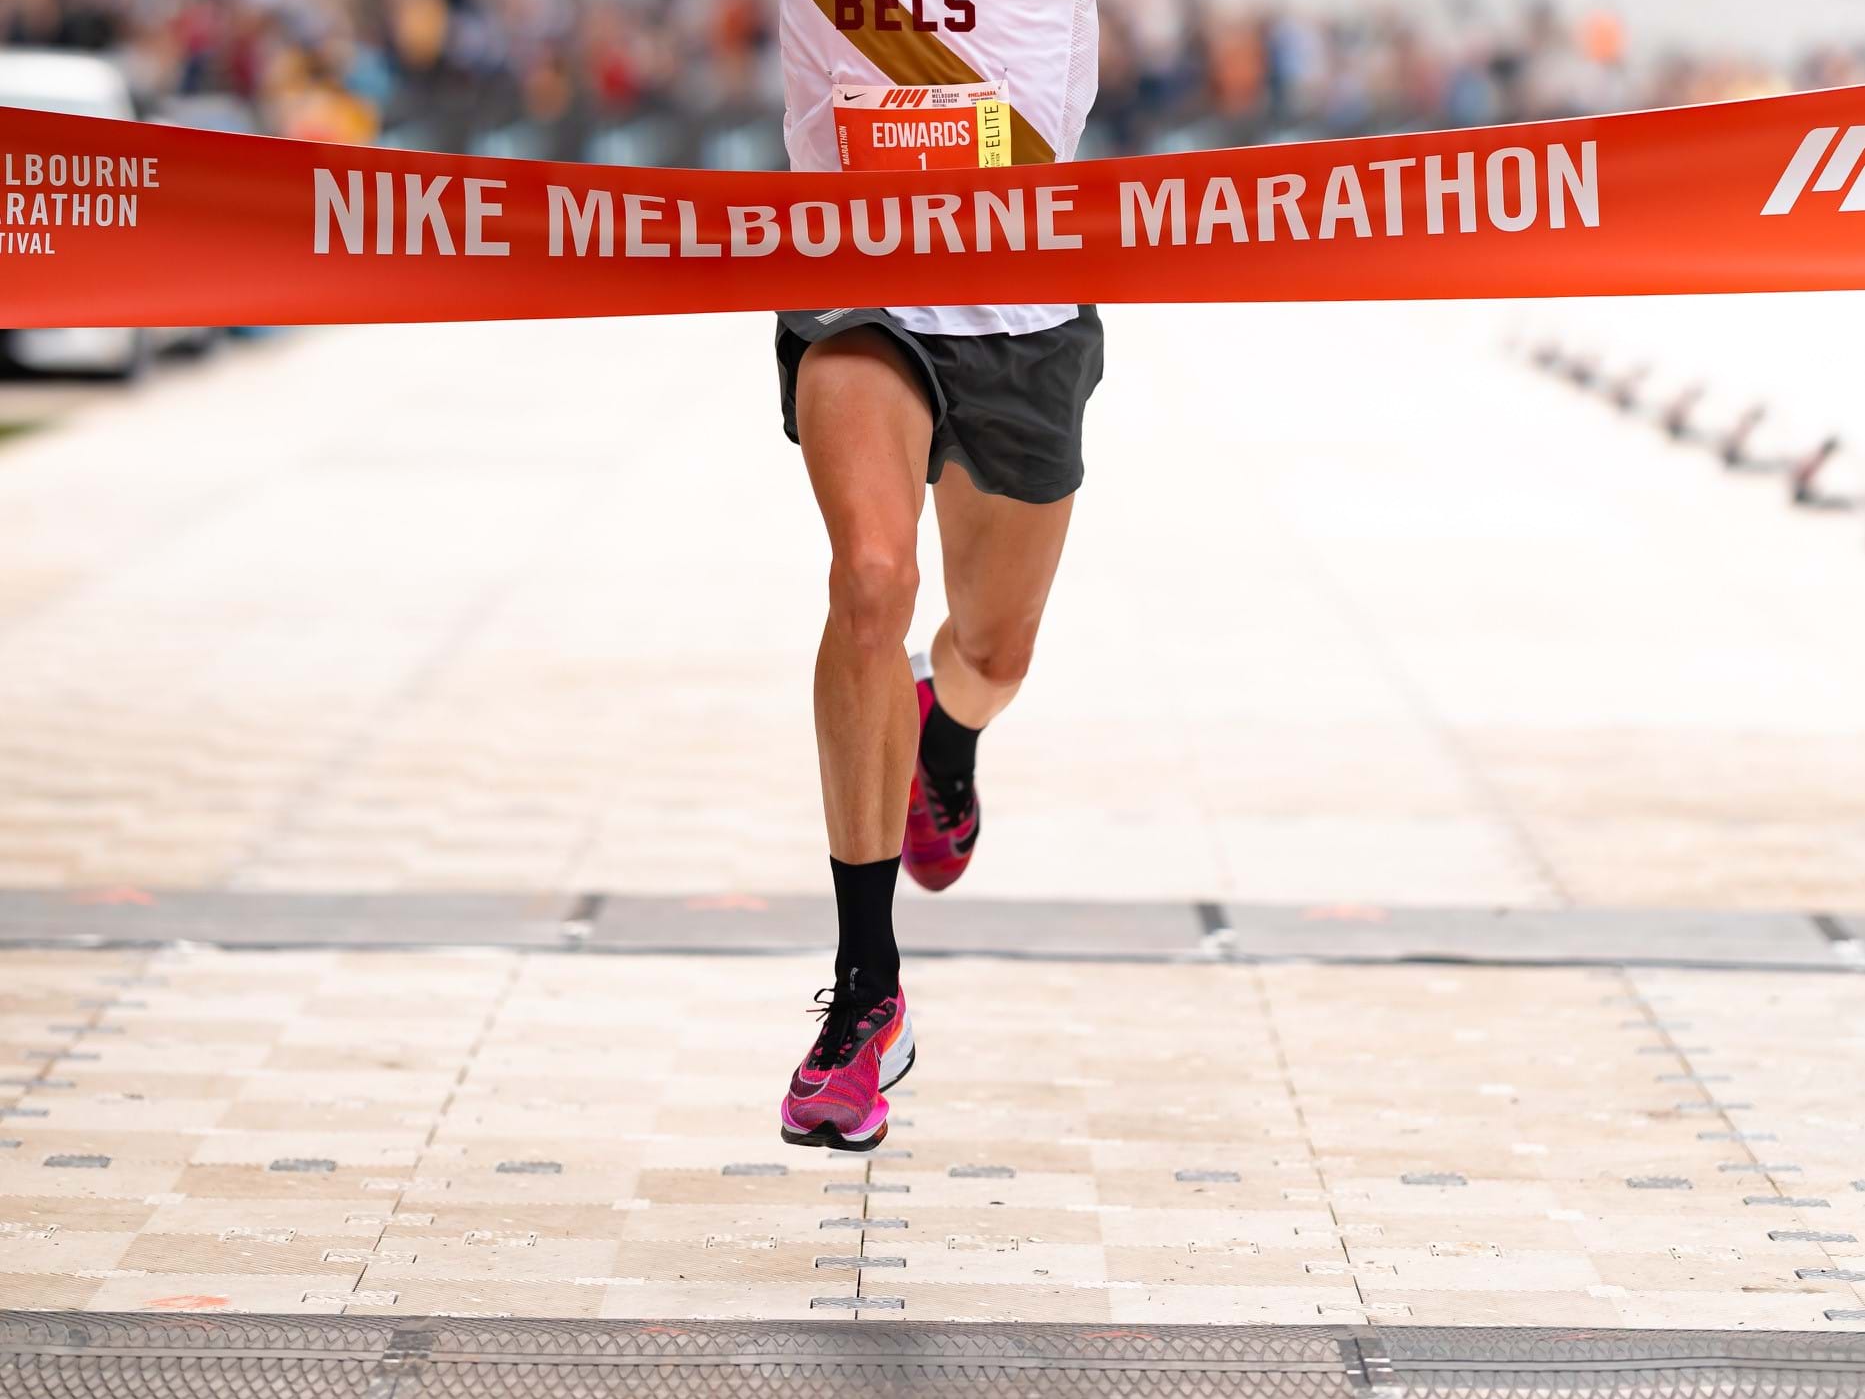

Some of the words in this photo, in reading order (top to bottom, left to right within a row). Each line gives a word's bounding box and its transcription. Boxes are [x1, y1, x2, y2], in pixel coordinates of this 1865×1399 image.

[838, 125, 851, 166] MARATHON
[871, 120, 971, 148] EDWARDS
[983, 104, 1001, 149] ELITE
[917, 152, 927, 170] 1
[0, 192, 137, 227] RATHON
[313, 168, 510, 257] NIKE
[546, 184, 1084, 259] MELBOURNE
[1119, 140, 1601, 248] MARATHON
